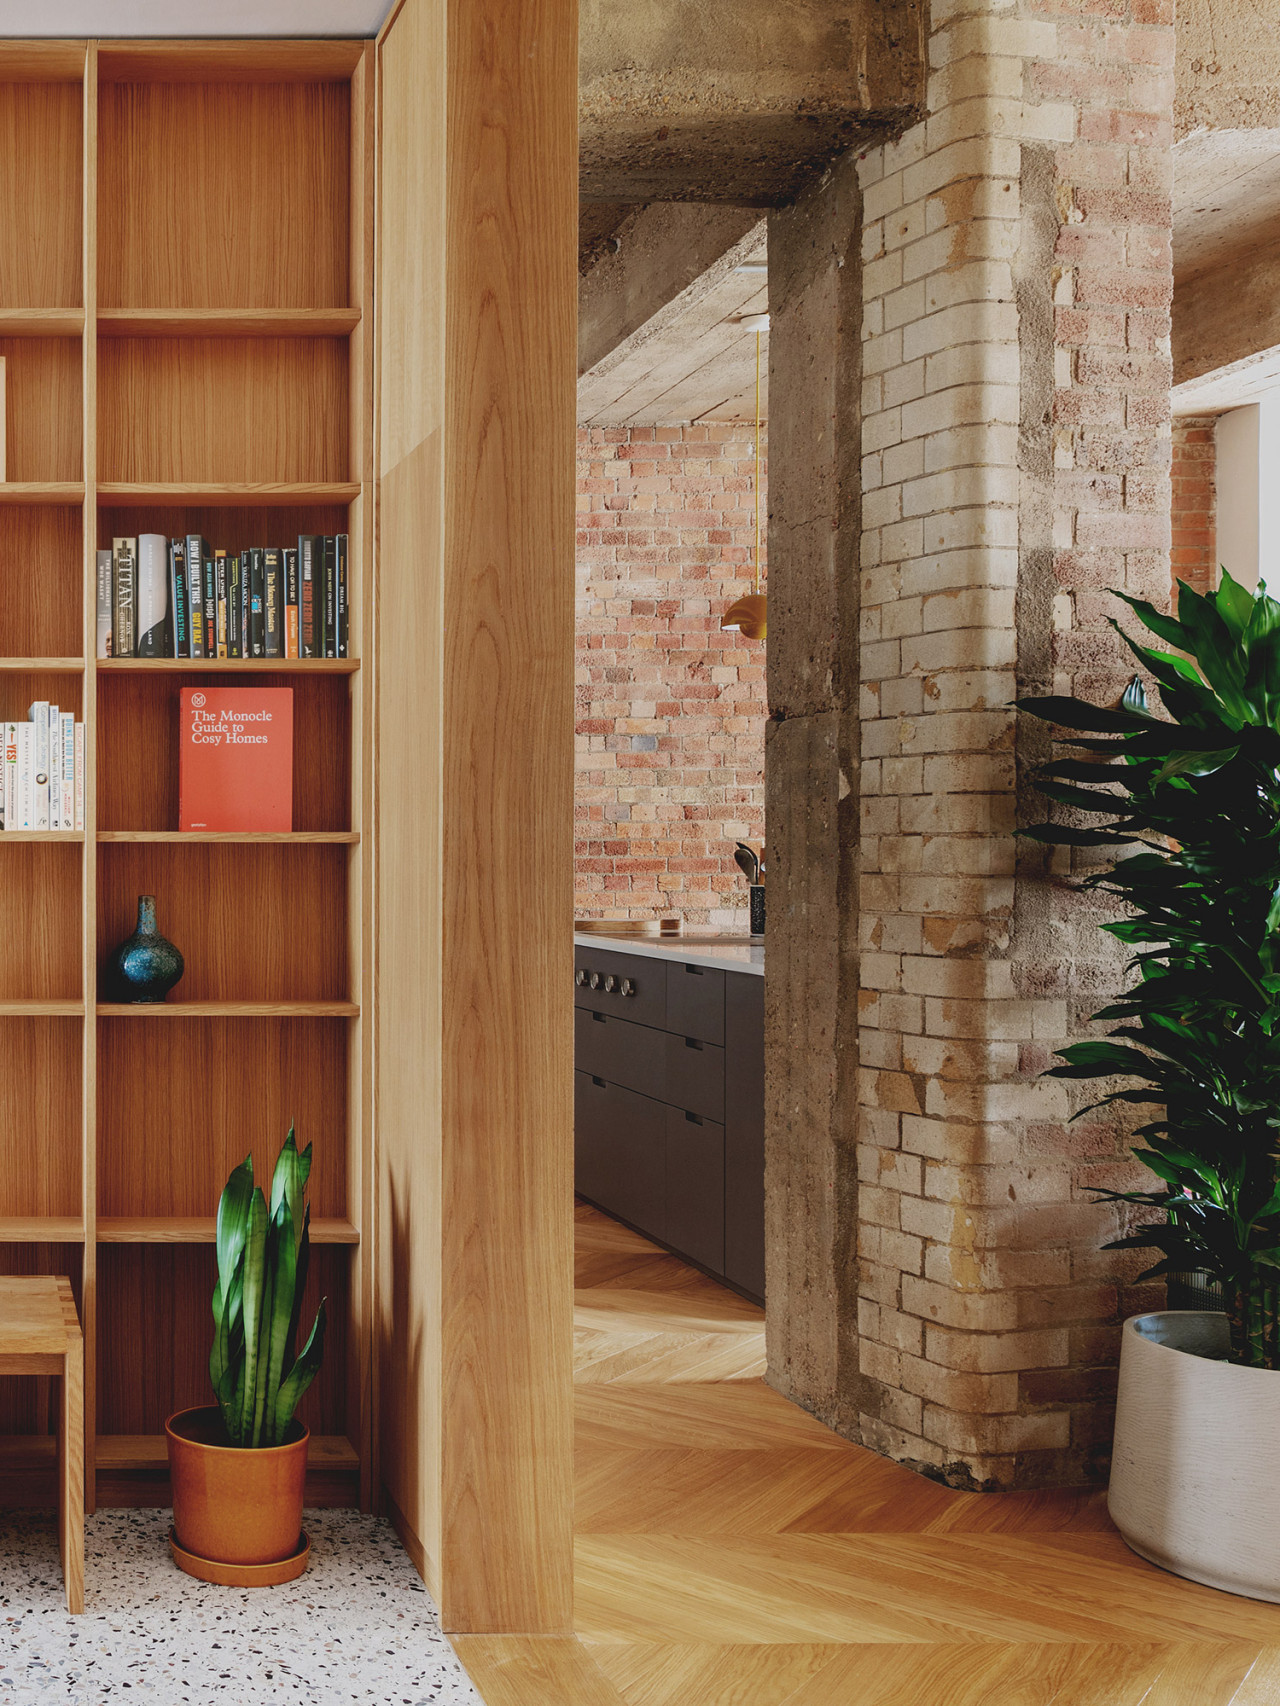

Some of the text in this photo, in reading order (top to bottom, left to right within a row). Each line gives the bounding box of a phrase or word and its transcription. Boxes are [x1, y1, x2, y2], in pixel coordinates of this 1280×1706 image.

[190, 540, 198, 558] HOW
[118, 554, 132, 610] TITAN
[192, 587, 200, 604] THIS
[266, 572, 276, 632] The Money Masters
[303, 582, 312, 644] ZERO ZERO ZERO
[192, 612, 202, 644] GUY RAZ
[191, 710, 272, 721] The Monocle
[191, 722, 244, 732] Guide to
[191, 732, 268, 746] Cosy Homes
[6, 744, 17, 764] YES!
